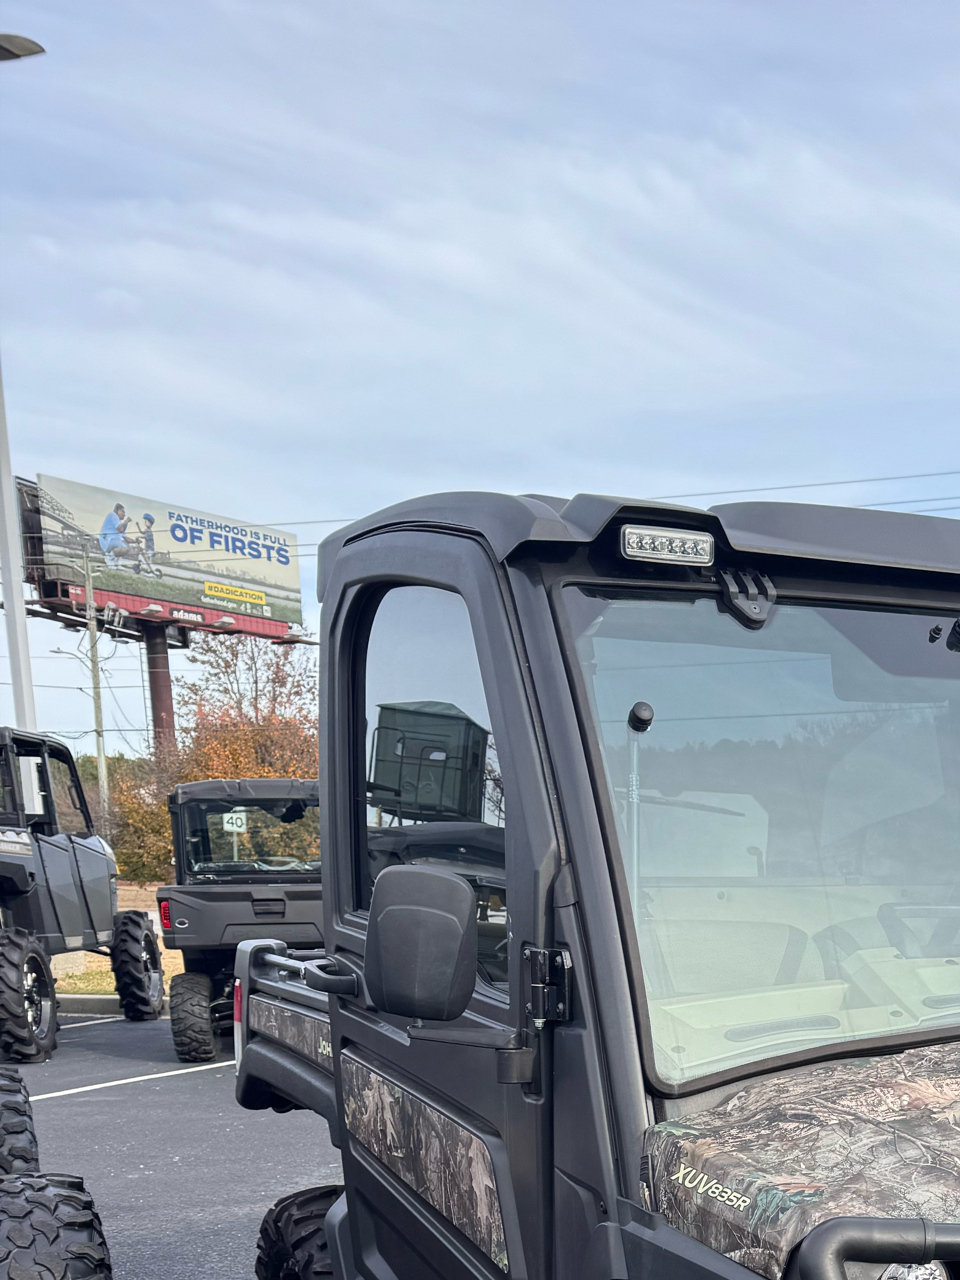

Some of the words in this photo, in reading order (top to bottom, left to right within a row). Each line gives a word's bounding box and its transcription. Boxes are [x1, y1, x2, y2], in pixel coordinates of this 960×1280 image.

[168, 511, 248, 537] FATHERHOOD
[250, 530, 261, 540] IS
[263, 533, 289, 547] FULL
[170, 523, 204, 545] OF
[208, 531, 291, 566] FIRSTS
[207, 584, 264, 602] #DADICATION
[172, 609, 203, 622] adams
[226, 816, 244, 829] 40
[318, 1037, 333, 1058] JOH
[671, 1163, 751, 1211] XUV835R
